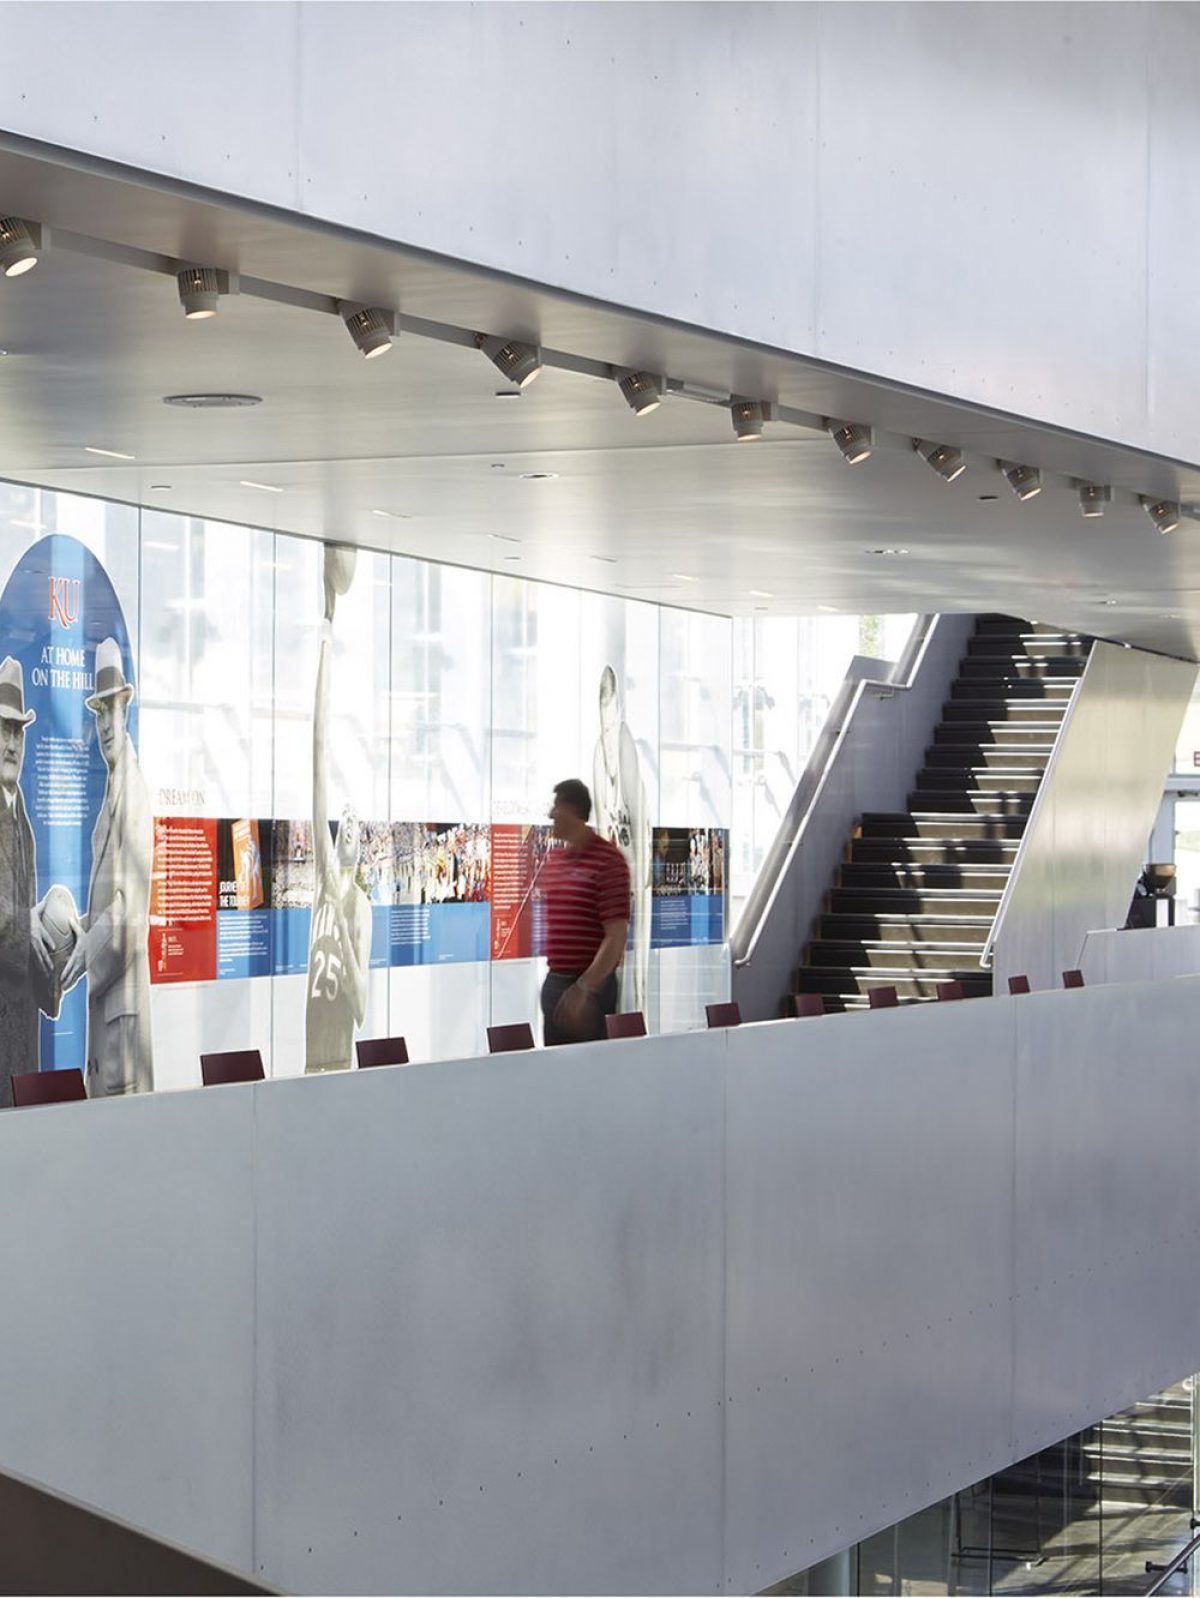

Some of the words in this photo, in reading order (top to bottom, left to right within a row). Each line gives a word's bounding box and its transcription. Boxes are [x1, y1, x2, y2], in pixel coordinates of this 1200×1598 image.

[48, 576, 80, 630] KU
[40, 646, 55, 664] AT
[56, 647, 86, 668] HOME
[31, 667, 49, 686] ON
[50, 669, 71, 689] THE
[72, 672, 94, 691] HILL
[311, 949, 342, 1001] 25
